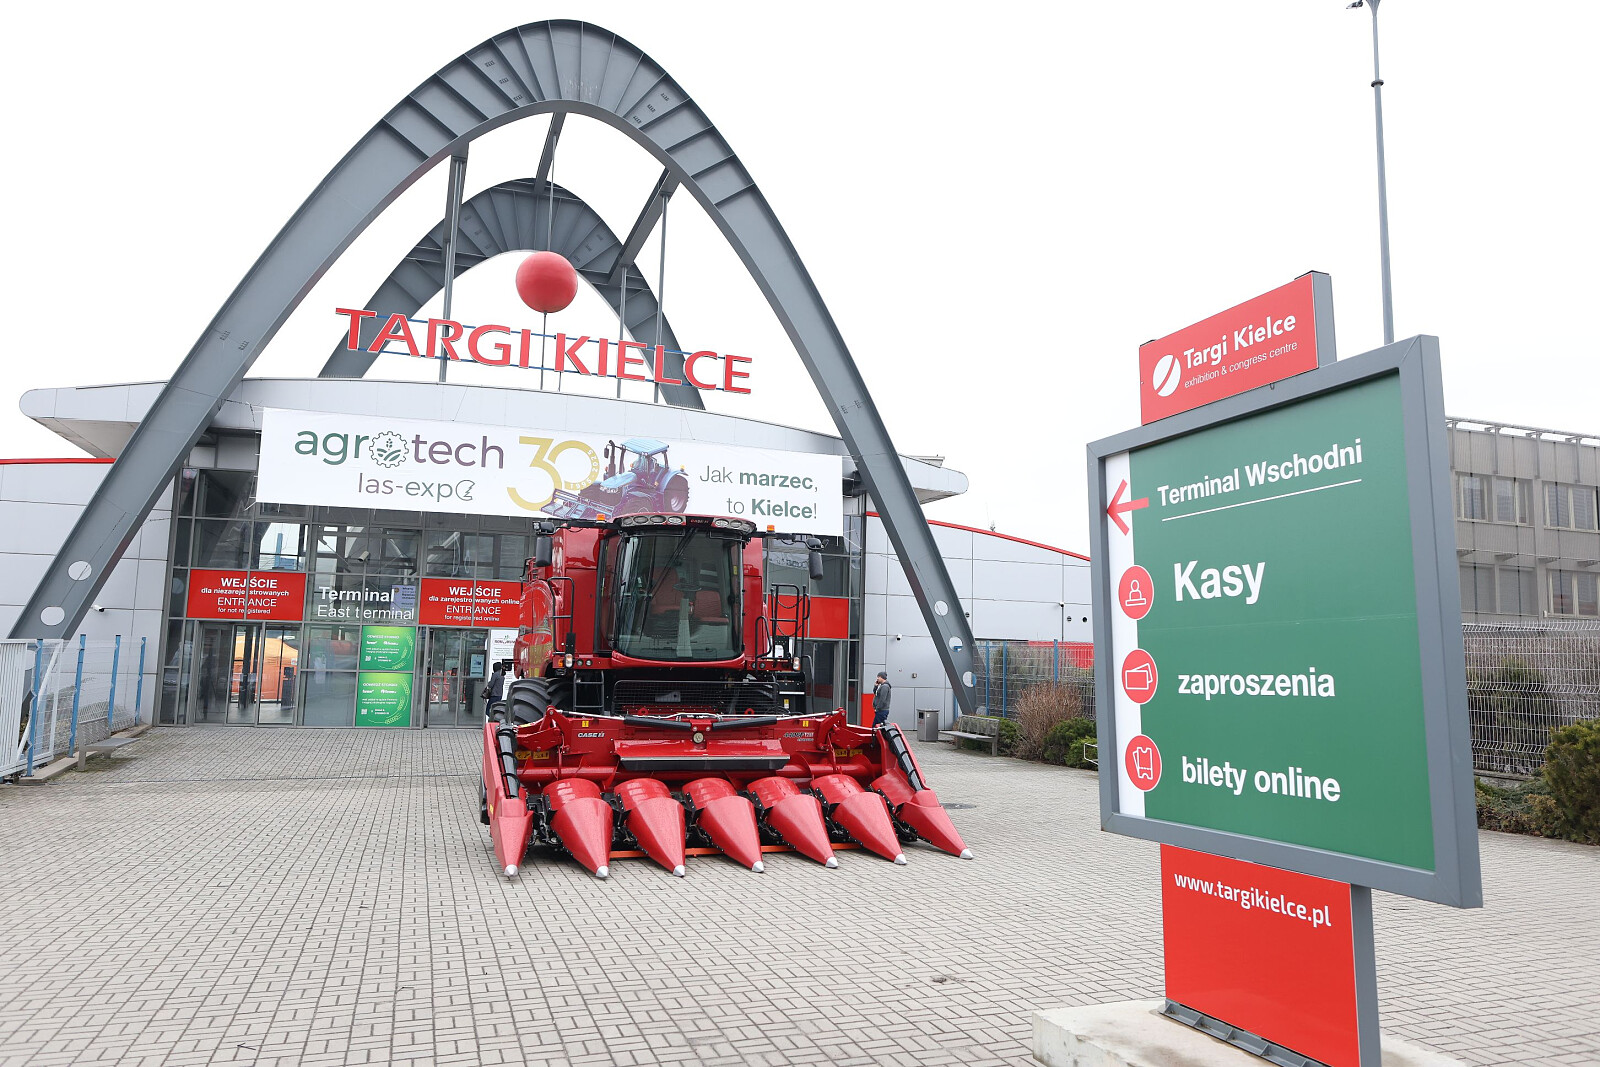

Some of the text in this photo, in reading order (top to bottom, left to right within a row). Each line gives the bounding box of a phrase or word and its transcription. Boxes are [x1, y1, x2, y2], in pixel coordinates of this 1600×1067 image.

[335, 307, 753, 395] TARGI KIELCE
[1183, 314, 1296, 369] Targi Kielce
[1184, 341, 1298, 389] exhibition & congress centre
[699, 464, 819, 493] Jak marzec,
[1156, 437, 1363, 507] Terminal Wschodni
[726, 496, 818, 520] to Kielce!
[220, 576, 278, 589] WEJŚCIE
[318, 586, 395, 602] Terminal
[448, 585, 502, 597] WEJŚCIE
[1173, 560, 1266, 605] Kasy
[217, 596, 277, 607] ENTRANCE
[317, 604, 415, 620] East terminal
[446, 604, 502, 615] ENTRANCE
[1177, 666, 1336, 701] zaproszenia
[1181, 755, 1342, 802] bilety online
[1174, 872, 1332, 928] www.targikielce.pl
